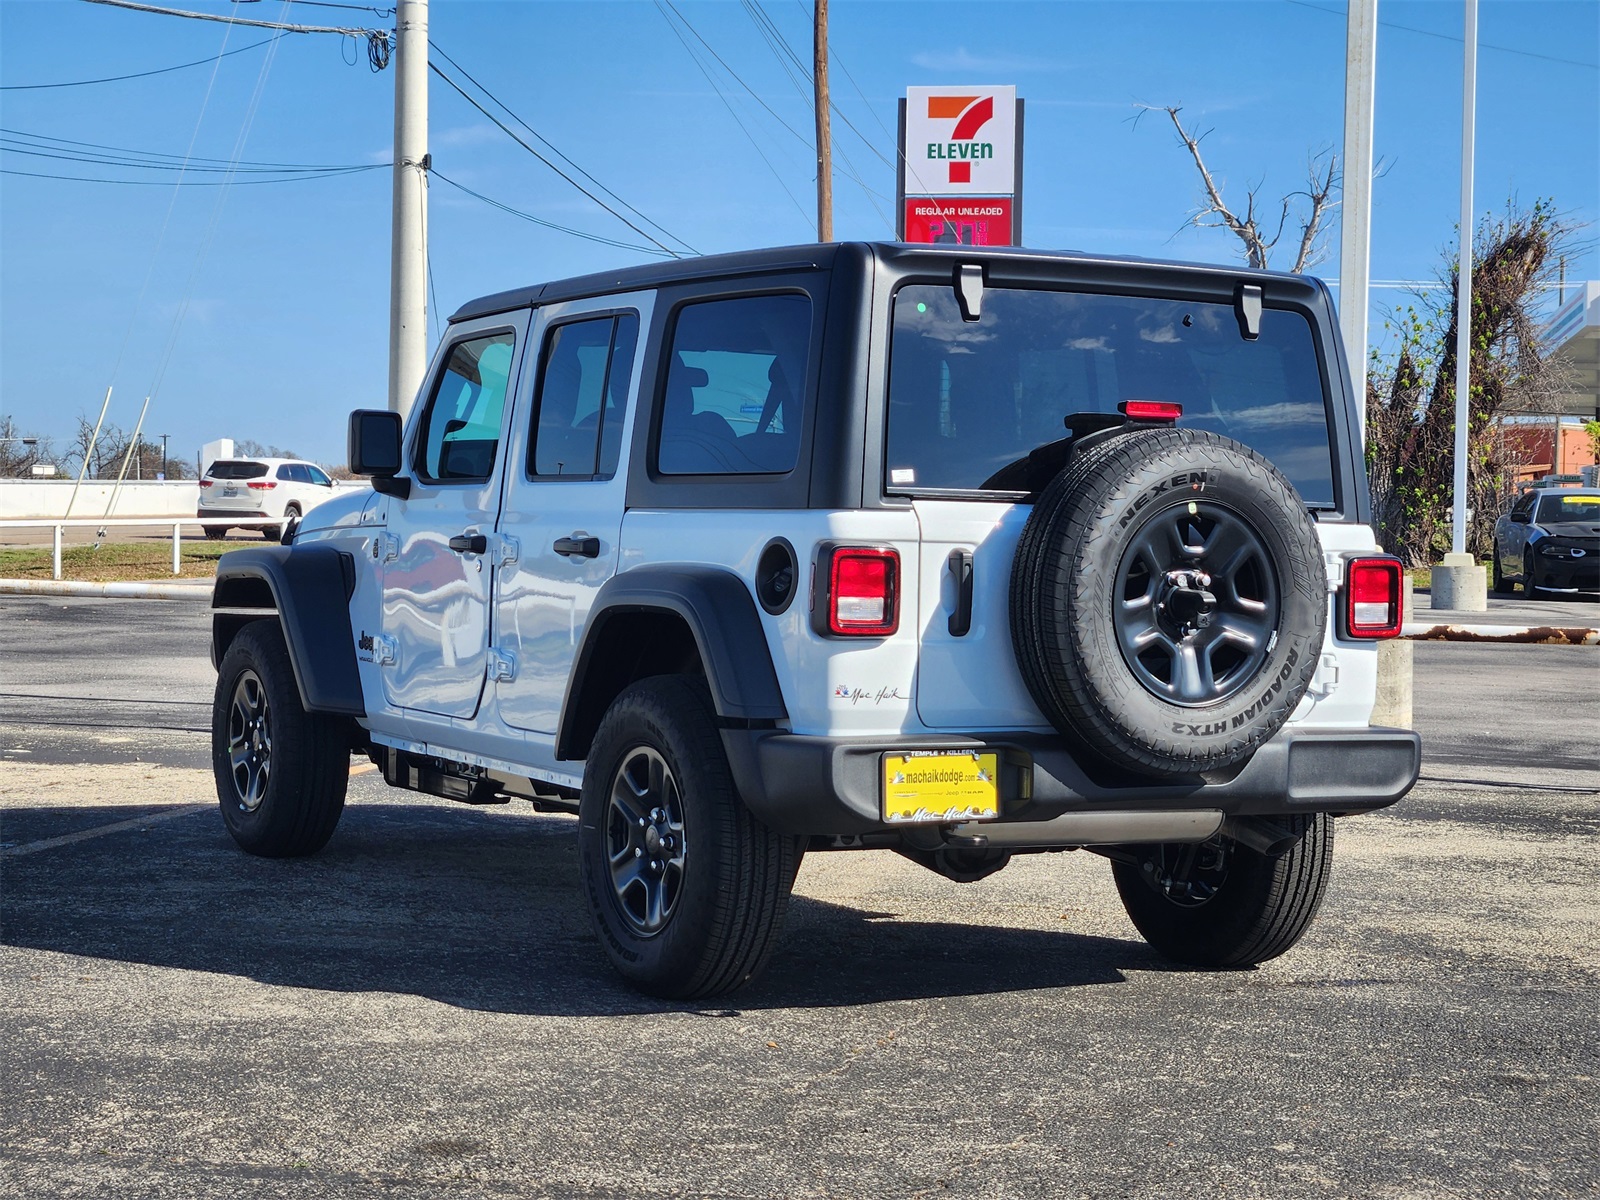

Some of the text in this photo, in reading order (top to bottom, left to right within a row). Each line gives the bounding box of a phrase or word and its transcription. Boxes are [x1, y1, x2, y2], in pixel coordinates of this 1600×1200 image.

[915, 207, 1003, 216] REGULAR UNLEADED
[1119, 471, 1208, 529] NEXEN
[851, 686, 913, 705] Mac Haik
[1231, 647, 1299, 729] ROADIAN
[1171, 720, 1227, 736] HTX2
[905, 768, 976, 786] machaikdodge.com
[912, 804, 980, 822] Mac Haik
